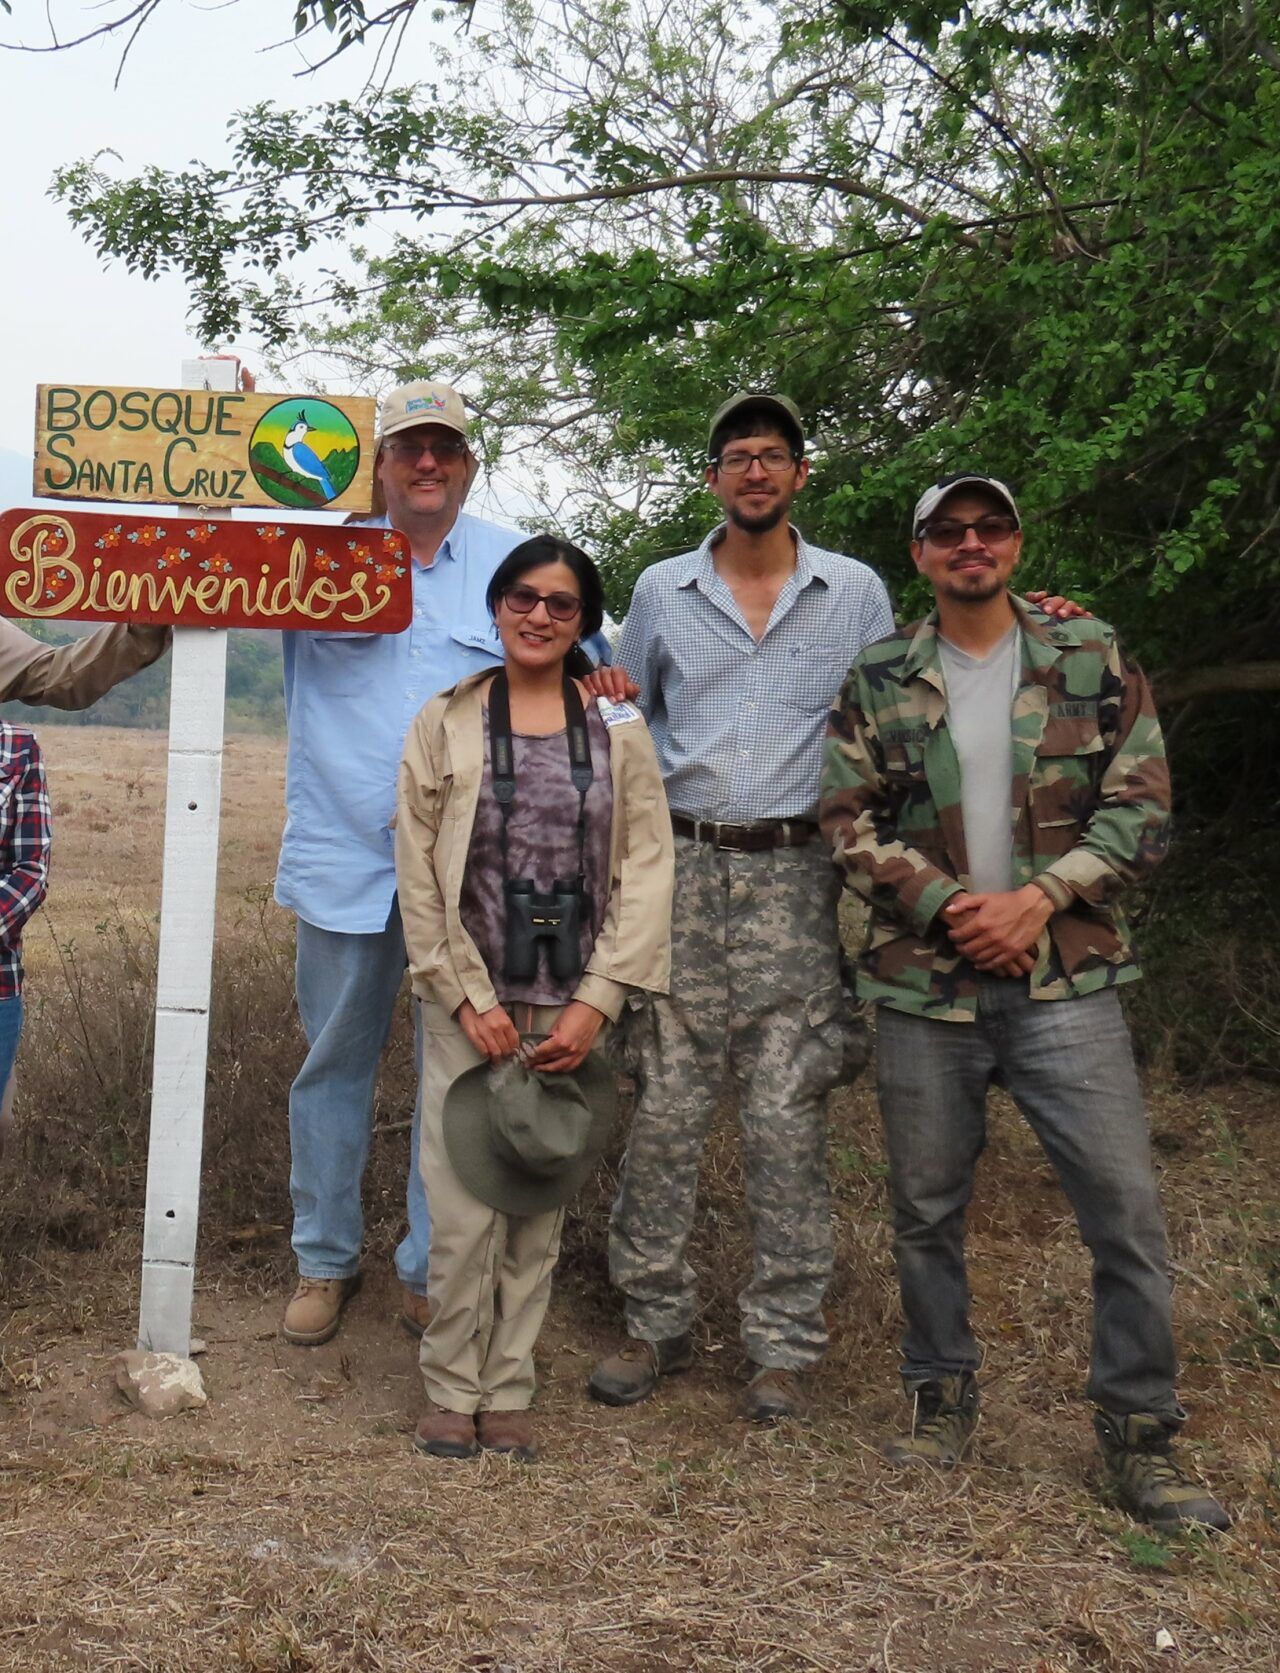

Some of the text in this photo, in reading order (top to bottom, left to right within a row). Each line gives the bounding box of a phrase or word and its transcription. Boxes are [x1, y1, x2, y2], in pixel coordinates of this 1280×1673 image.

[46, 387, 246, 436] BOSQUE
[44, 432, 247, 500] SANTA CRUZ
[4, 514, 392, 623] Bienvenidos
